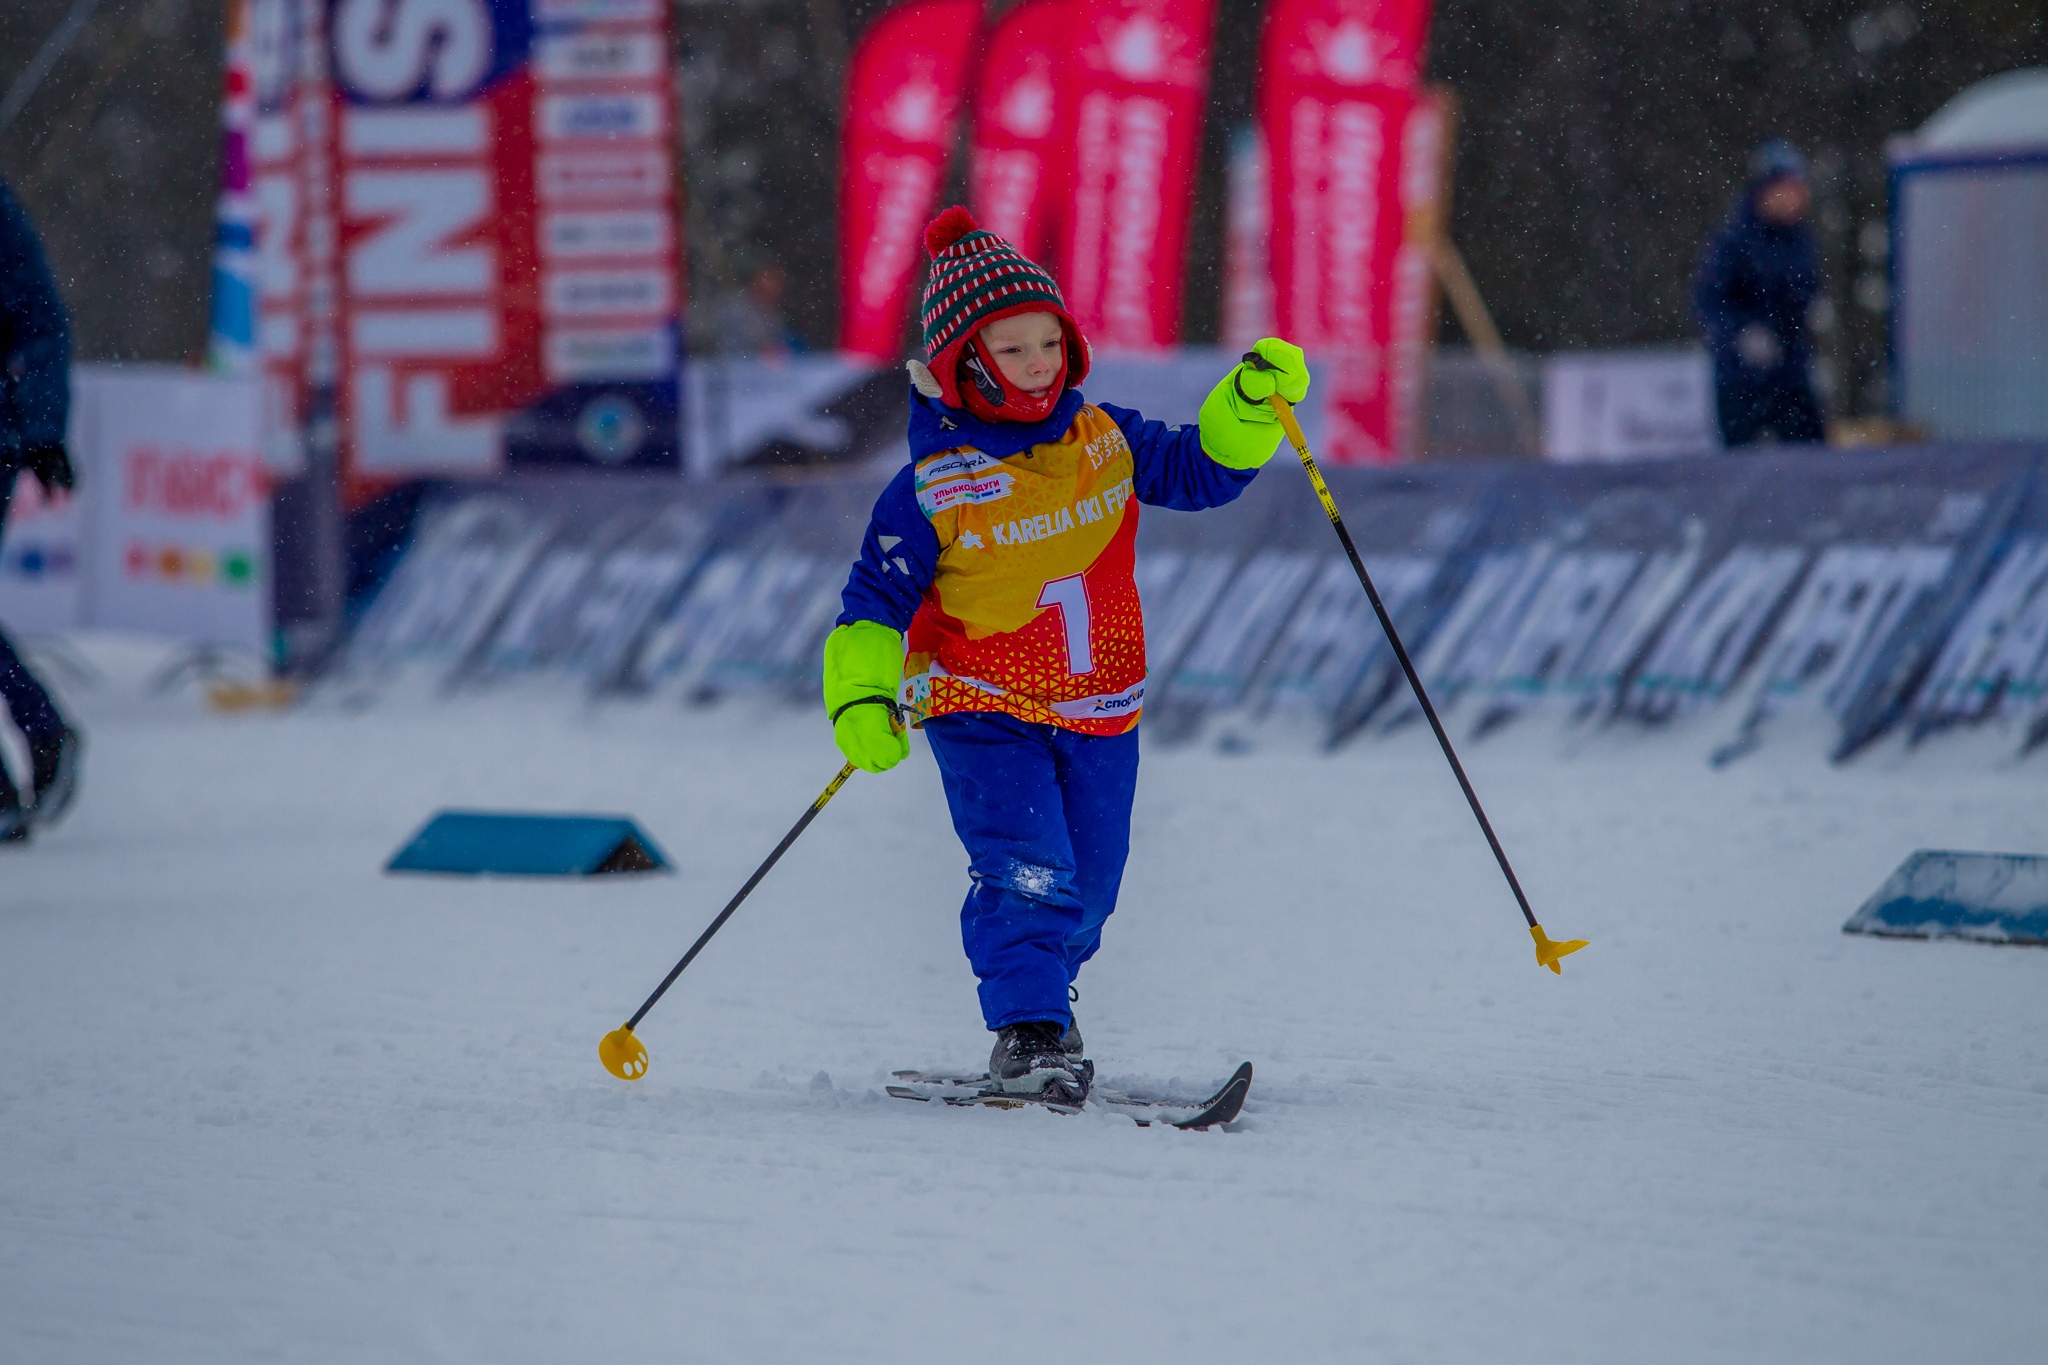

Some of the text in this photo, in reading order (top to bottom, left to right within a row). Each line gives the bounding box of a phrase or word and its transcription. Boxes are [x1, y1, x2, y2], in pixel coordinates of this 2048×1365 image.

[929, 459, 977, 476] FISCHR
[992, 478, 1132, 545] KARELIA SKI FET
[1034, 570, 1096, 678] 1
